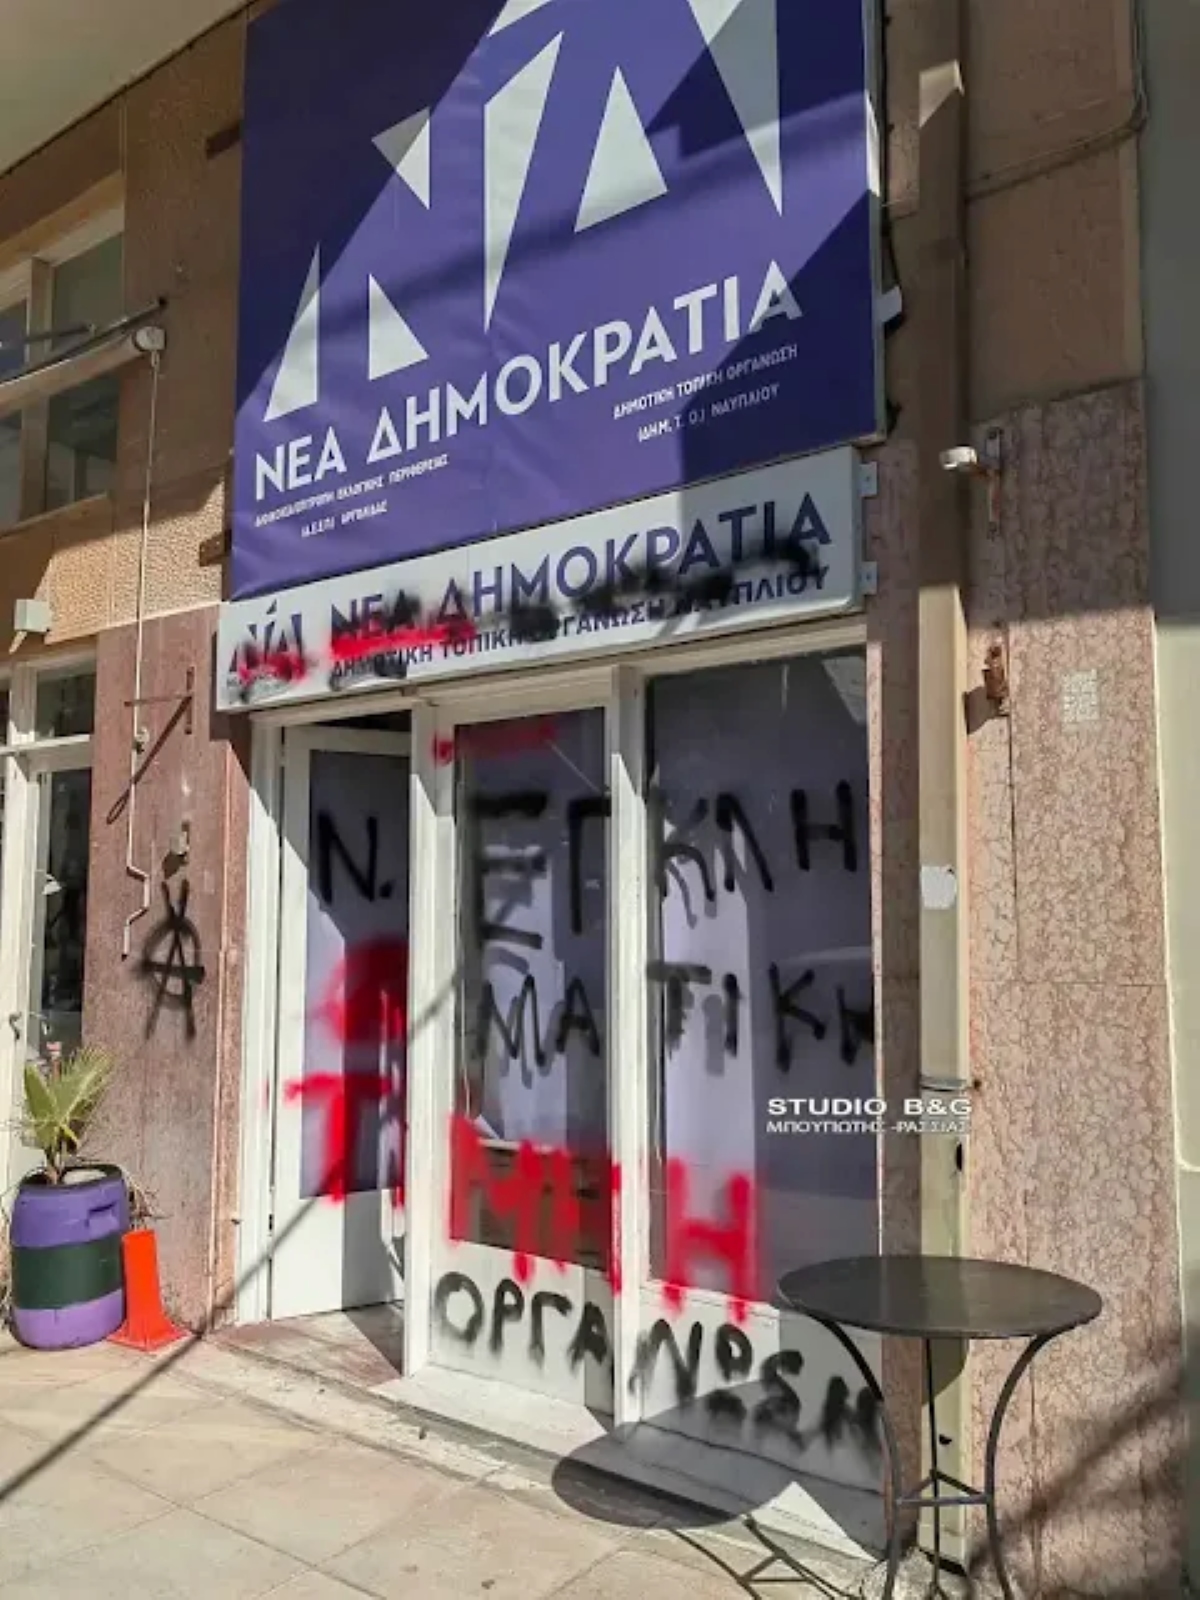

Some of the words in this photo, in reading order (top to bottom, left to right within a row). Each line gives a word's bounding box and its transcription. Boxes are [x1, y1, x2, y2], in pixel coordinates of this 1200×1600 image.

[255, 426, 347, 500] ΝΕΑ
[366, 259, 803, 463] ΔΗΜΟΚΡΑΤΙΑ
[726, 344, 798, 380] ΟΡΓΑΝΩΣΗ
[711, 383, 780, 417] ΝΑΥΠΛΙΟΥ
